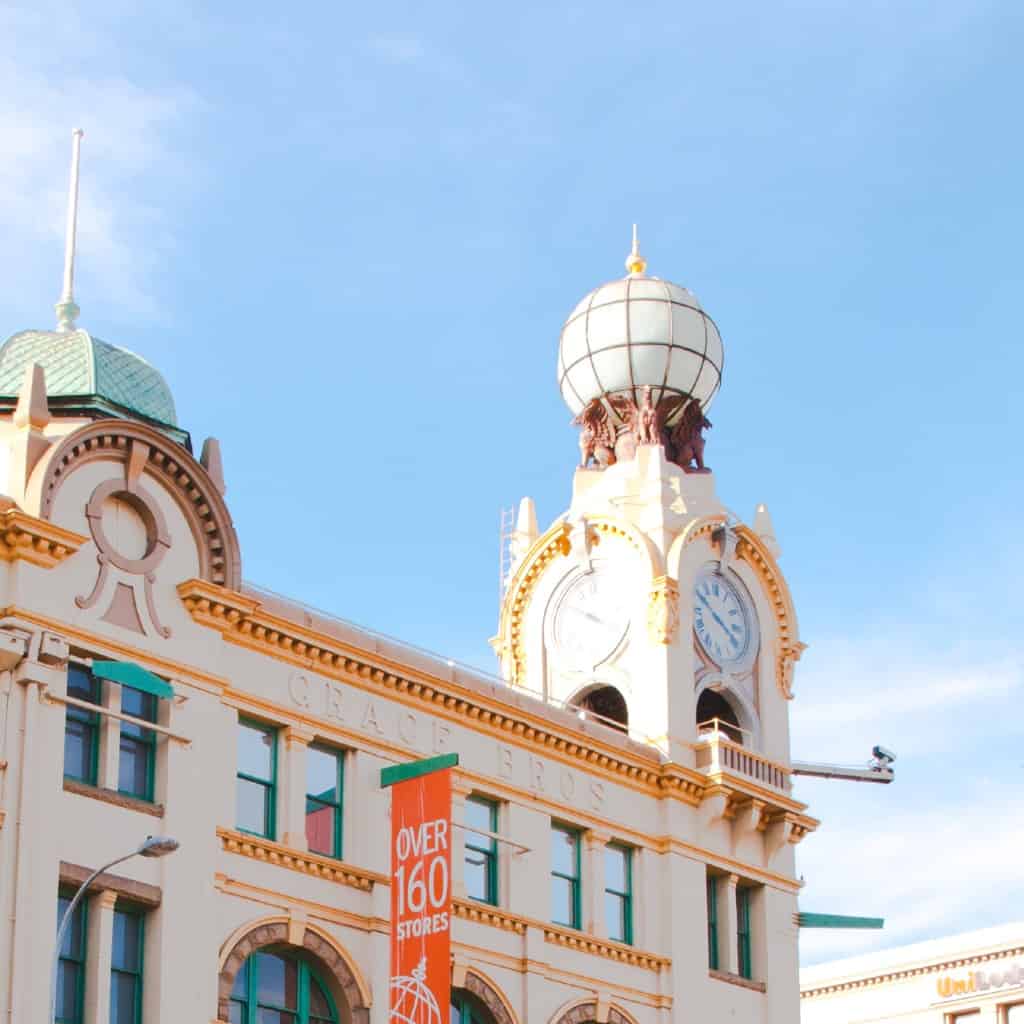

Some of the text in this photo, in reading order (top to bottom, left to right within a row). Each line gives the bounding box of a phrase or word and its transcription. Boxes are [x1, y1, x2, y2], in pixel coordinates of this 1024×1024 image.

[396, 819, 449, 862] OVER
[394, 855, 449, 916] 160
[397, 911, 449, 941] STORES
